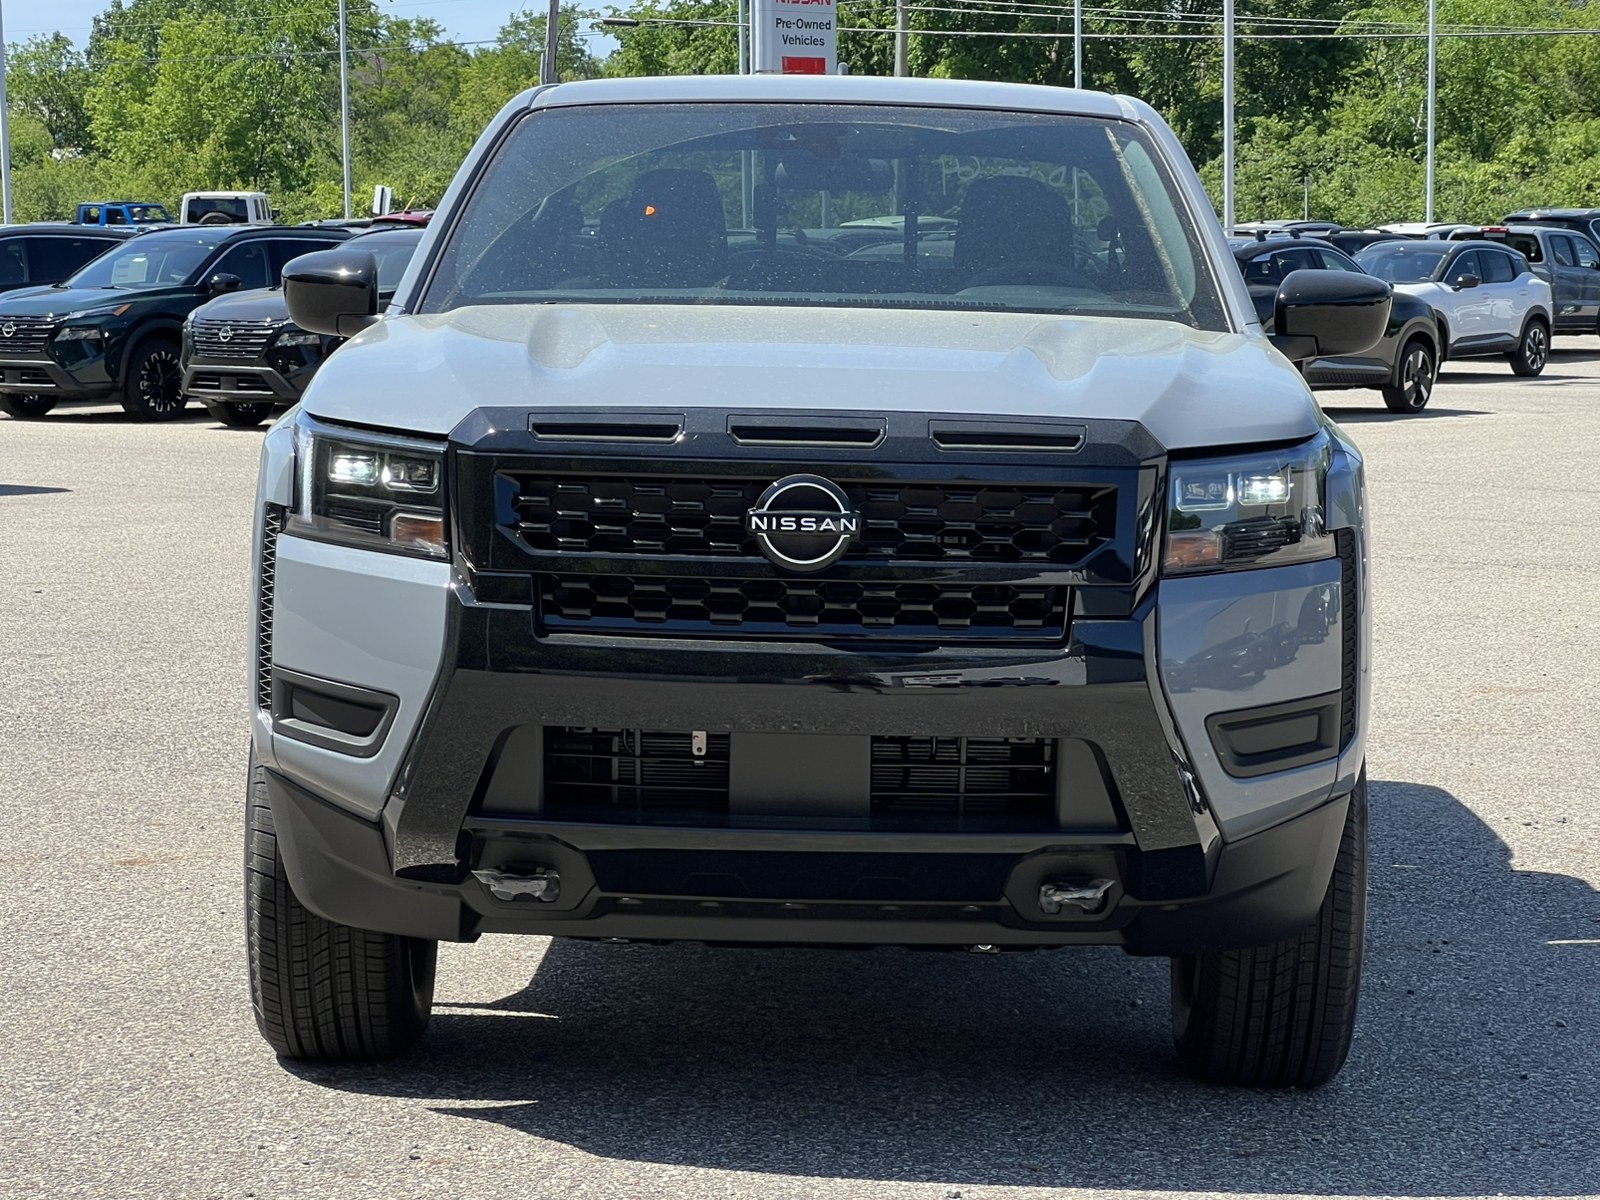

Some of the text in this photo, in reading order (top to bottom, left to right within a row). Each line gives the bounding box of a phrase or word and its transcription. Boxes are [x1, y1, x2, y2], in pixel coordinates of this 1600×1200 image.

[775, 18, 832, 30] Pre-Owned
[782, 34, 825, 46] Vehicles
[751, 516, 857, 532] NISSAN
